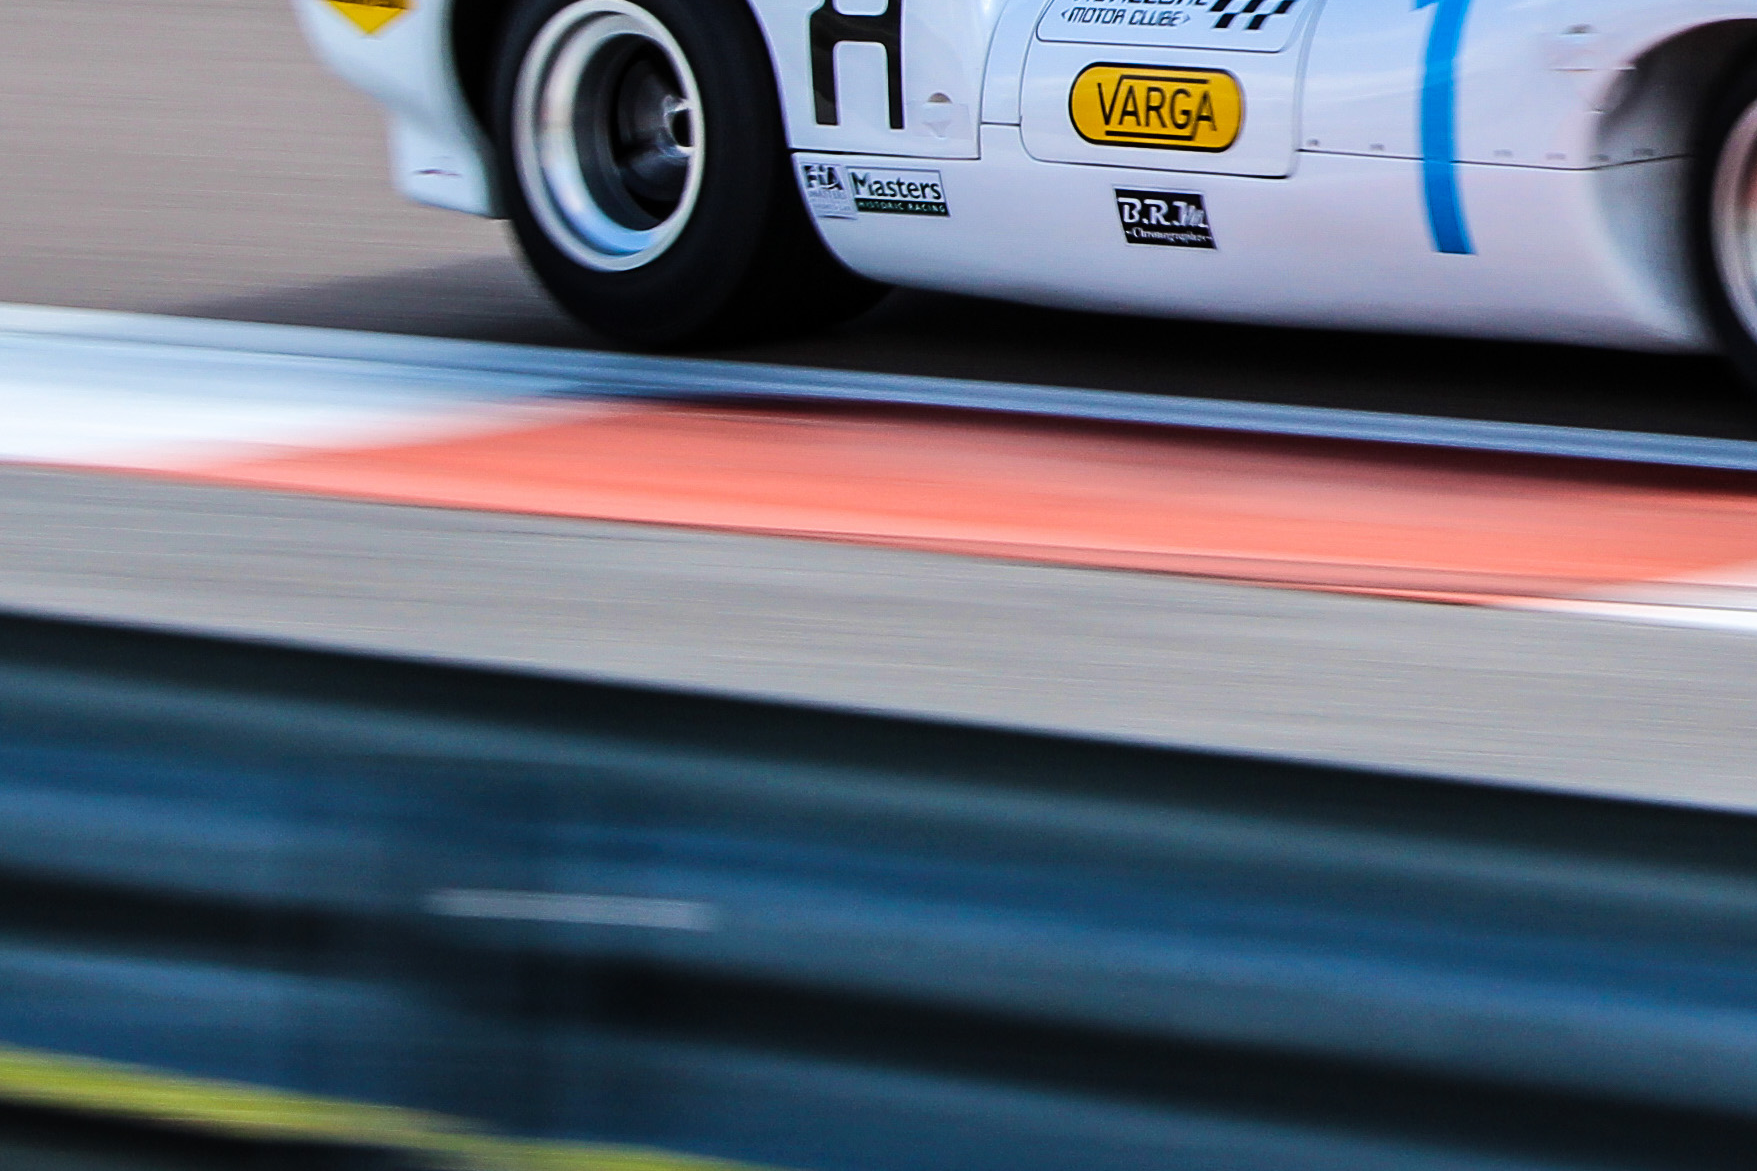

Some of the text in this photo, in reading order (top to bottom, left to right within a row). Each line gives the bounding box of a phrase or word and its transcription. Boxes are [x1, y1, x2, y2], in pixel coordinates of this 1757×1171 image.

[1097, 74, 1218, 141] VARGA
[850, 171, 942, 200] Masters
[857, 200, 904, 212] HISTORIC
[907, 201, 946, 214] RACING
